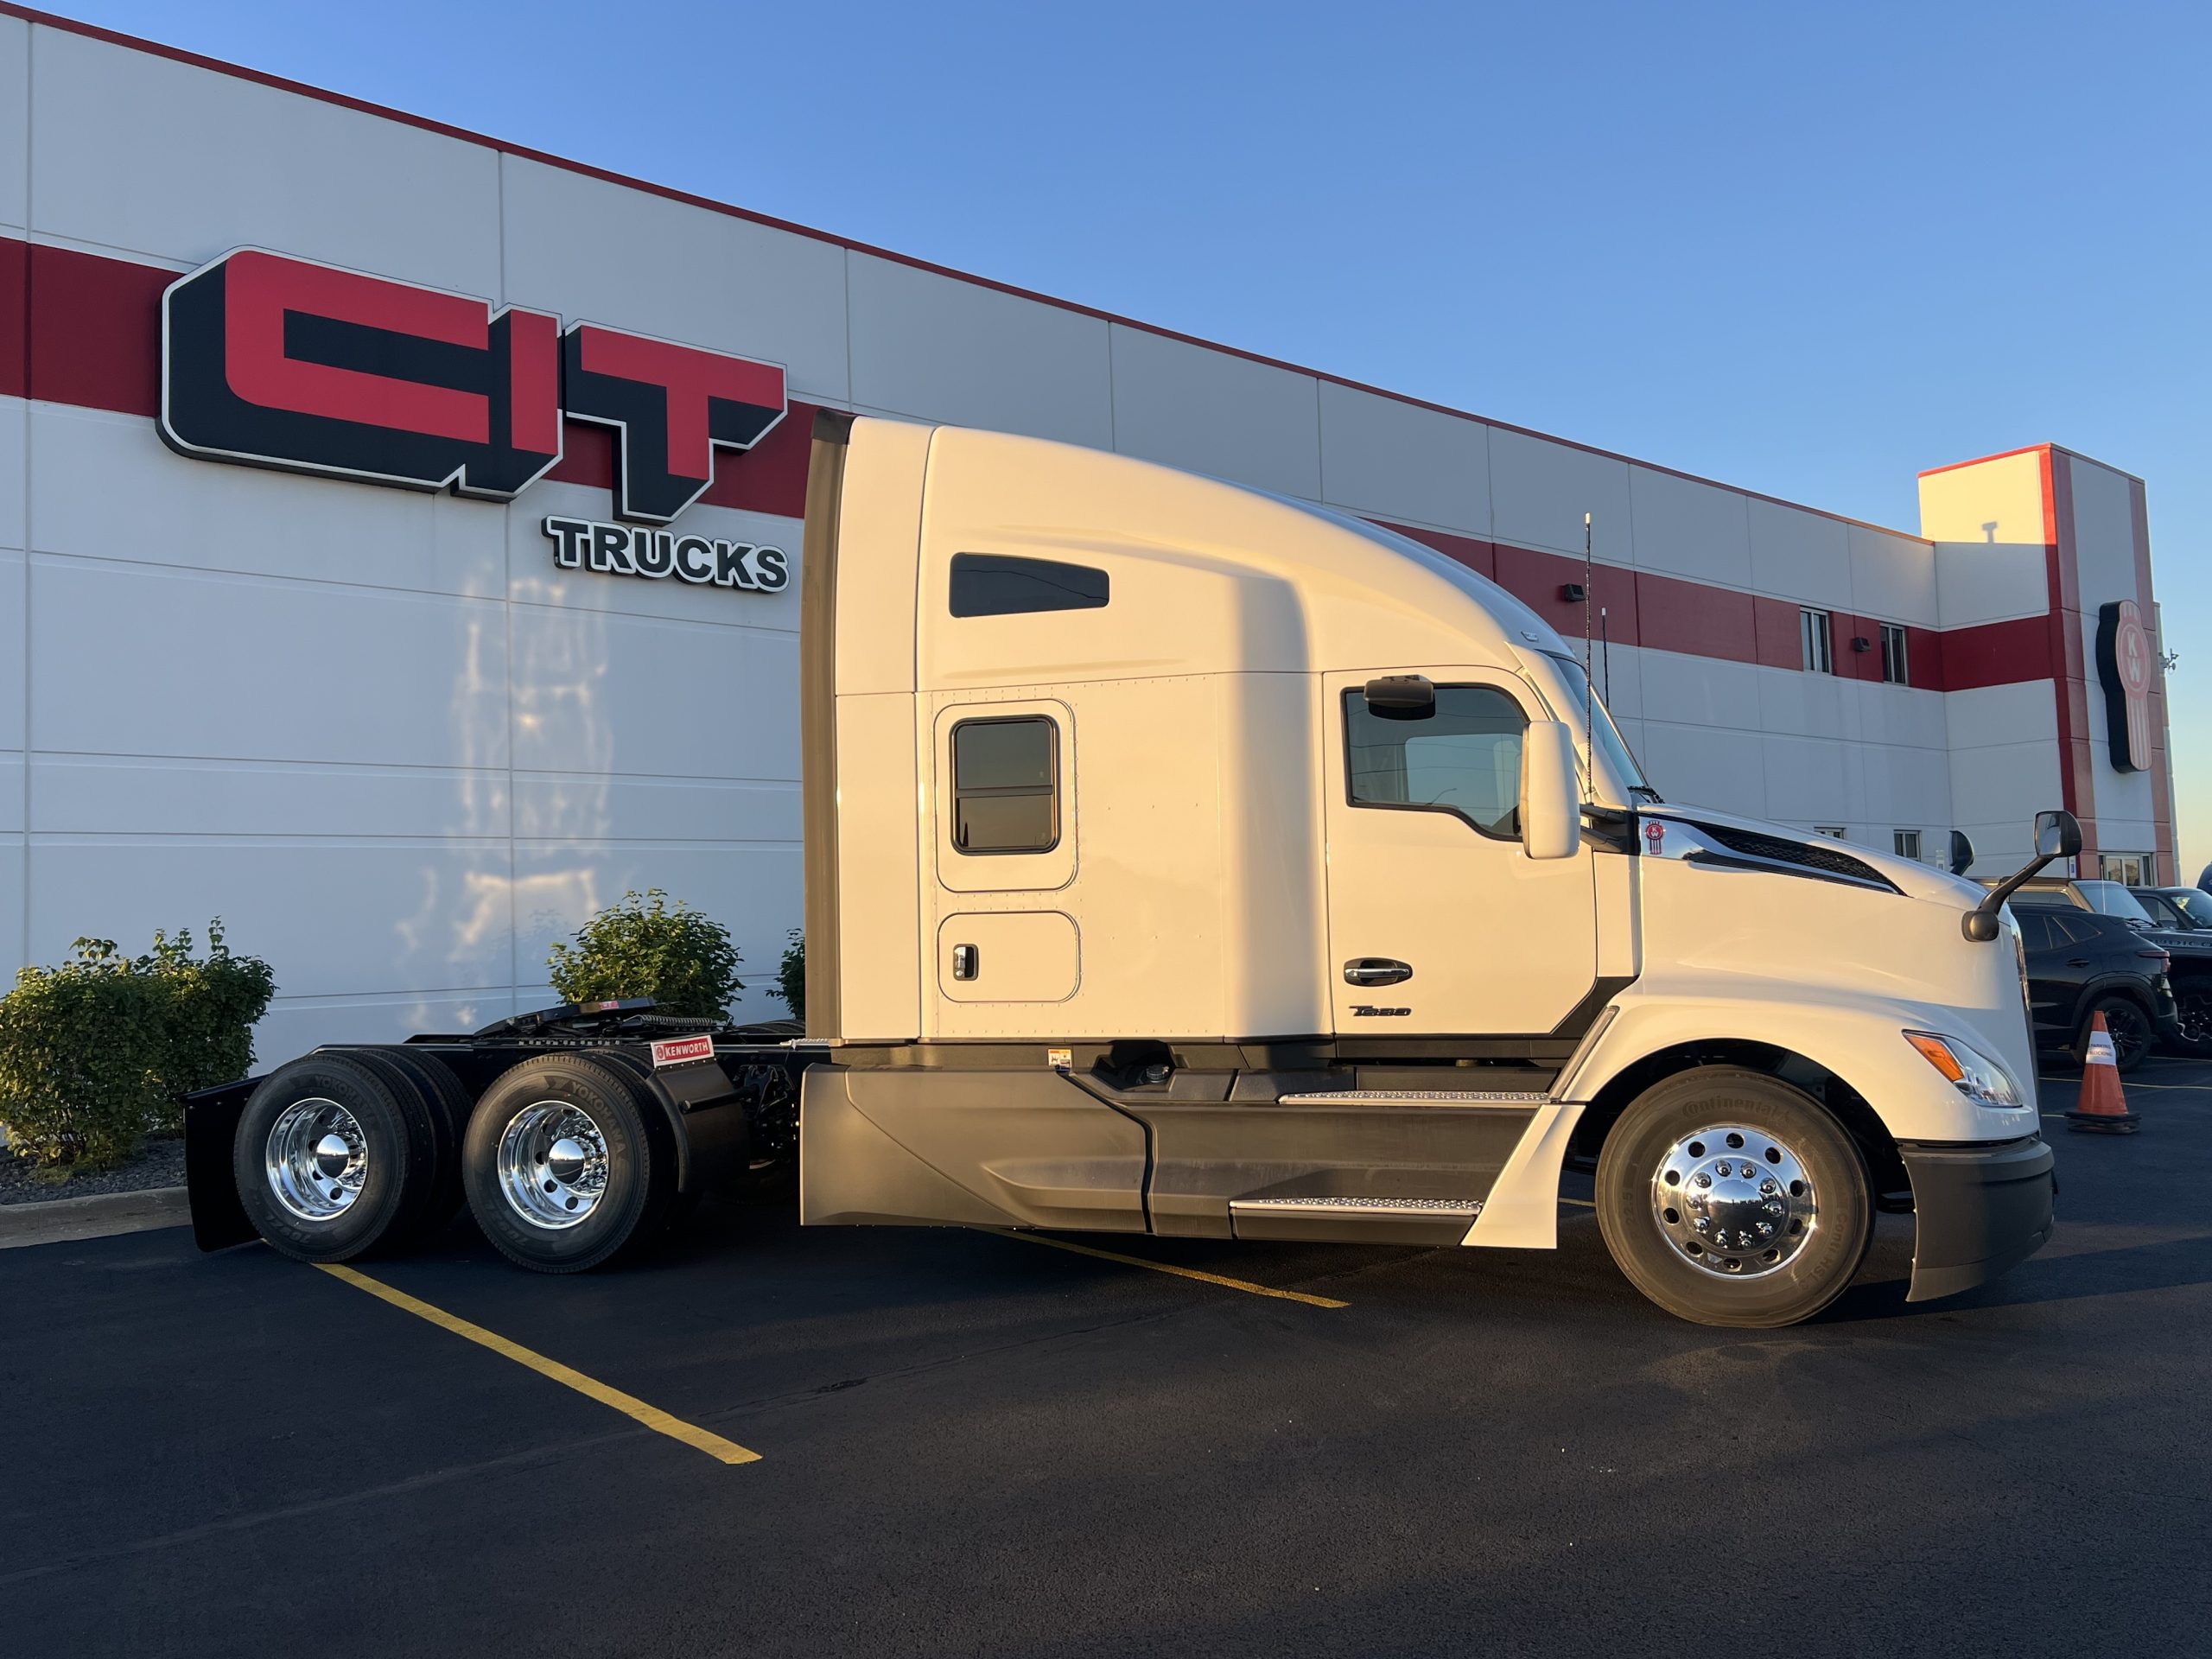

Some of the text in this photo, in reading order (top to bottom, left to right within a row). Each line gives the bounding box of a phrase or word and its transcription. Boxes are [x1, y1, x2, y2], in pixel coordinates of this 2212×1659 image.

[186, 246, 786, 505] CIT
[547, 518, 788, 592] TRUCKS
[665, 1042, 708, 1057] KENWORTH
[315, 1076, 376, 1122] YOKOHAMA
[570, 1082, 627, 1154] YOKOHAMA
[1681, 1096, 1778, 1119] Continental
